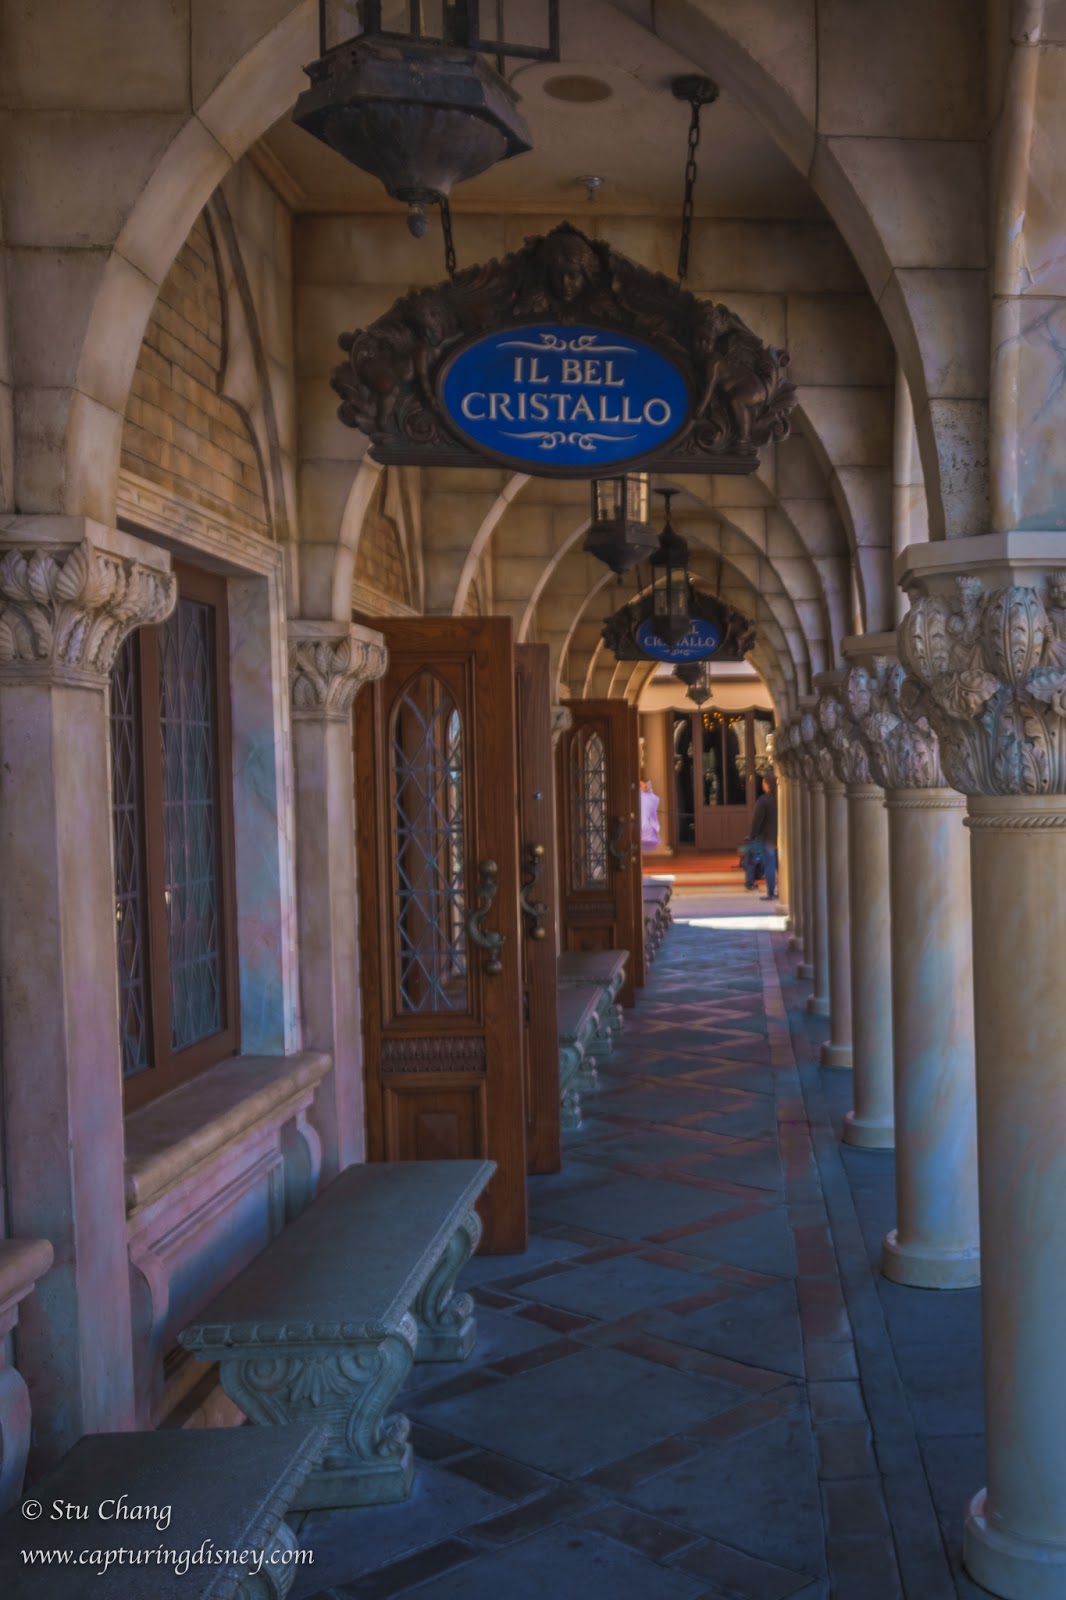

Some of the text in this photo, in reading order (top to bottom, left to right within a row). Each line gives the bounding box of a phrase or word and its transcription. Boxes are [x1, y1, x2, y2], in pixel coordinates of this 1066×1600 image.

[513, 356, 625, 387] IL BEL
[460, 391, 672, 426] CRISTALLO
